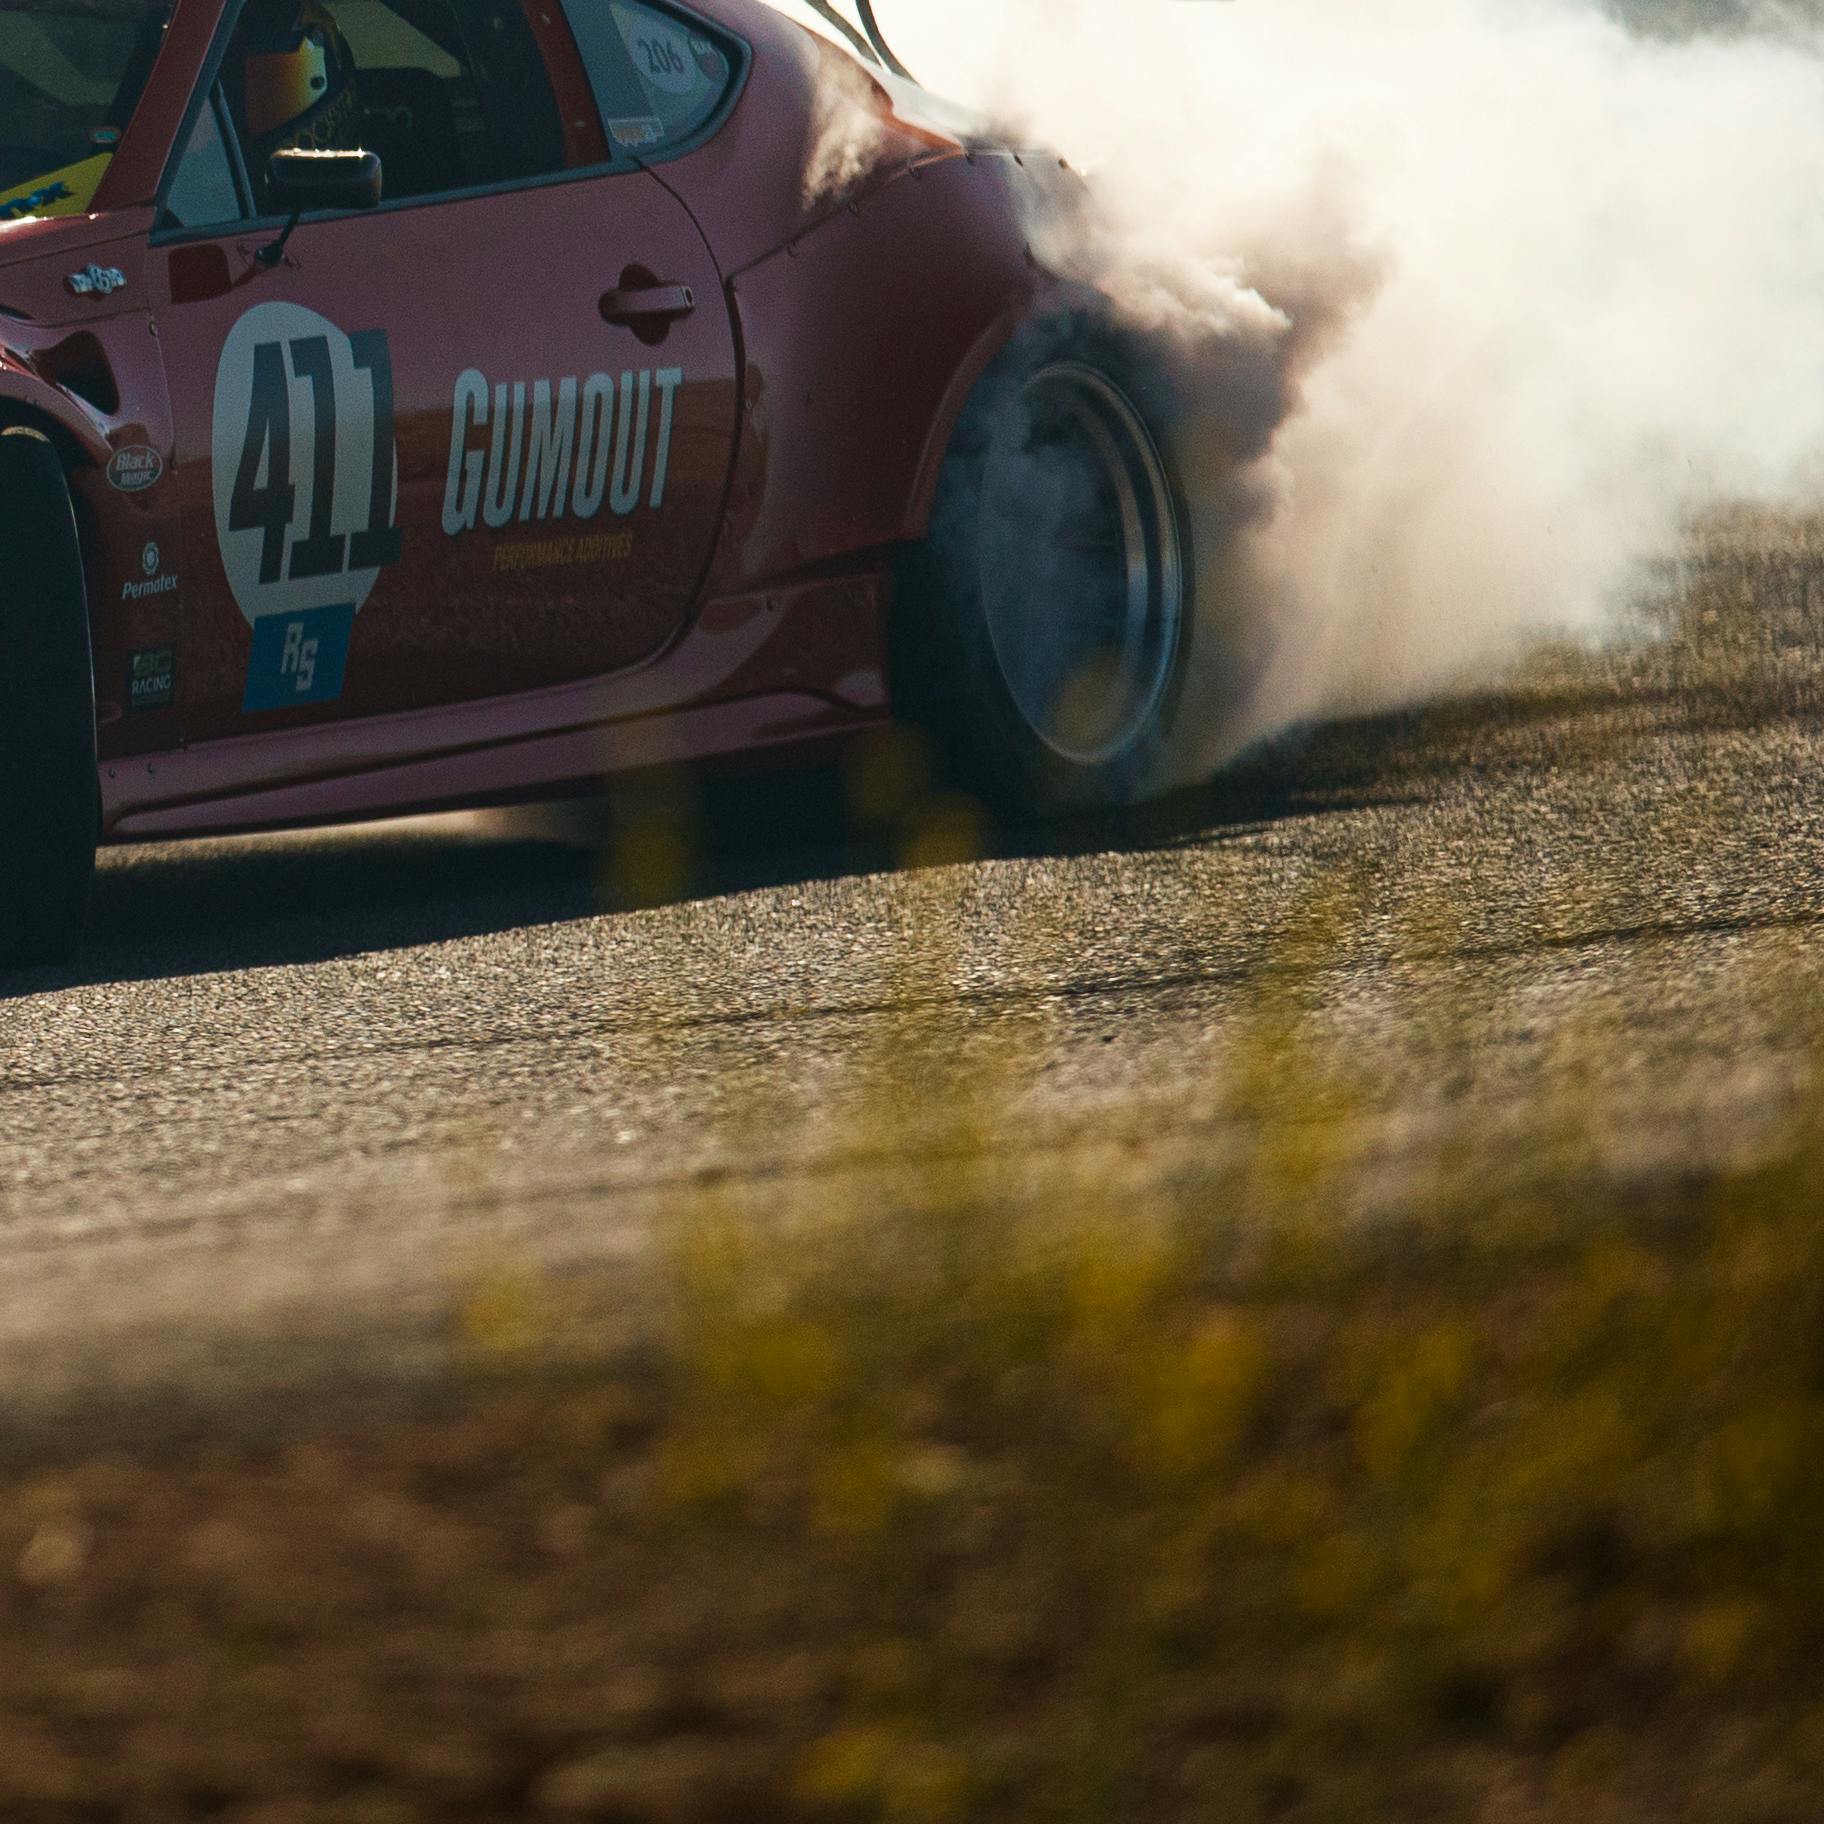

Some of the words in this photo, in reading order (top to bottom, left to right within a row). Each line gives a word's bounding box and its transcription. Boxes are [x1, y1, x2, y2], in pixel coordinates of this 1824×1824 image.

[636, 38, 685, 75] 206
[115, 450, 154, 471] Black
[227, 327, 404, 586] 411
[440, 366, 683, 537] GUMOUT
[121, 574, 178, 600] Permatex
[280, 621, 319, 692] RS
[131, 674, 172, 695] RACING
